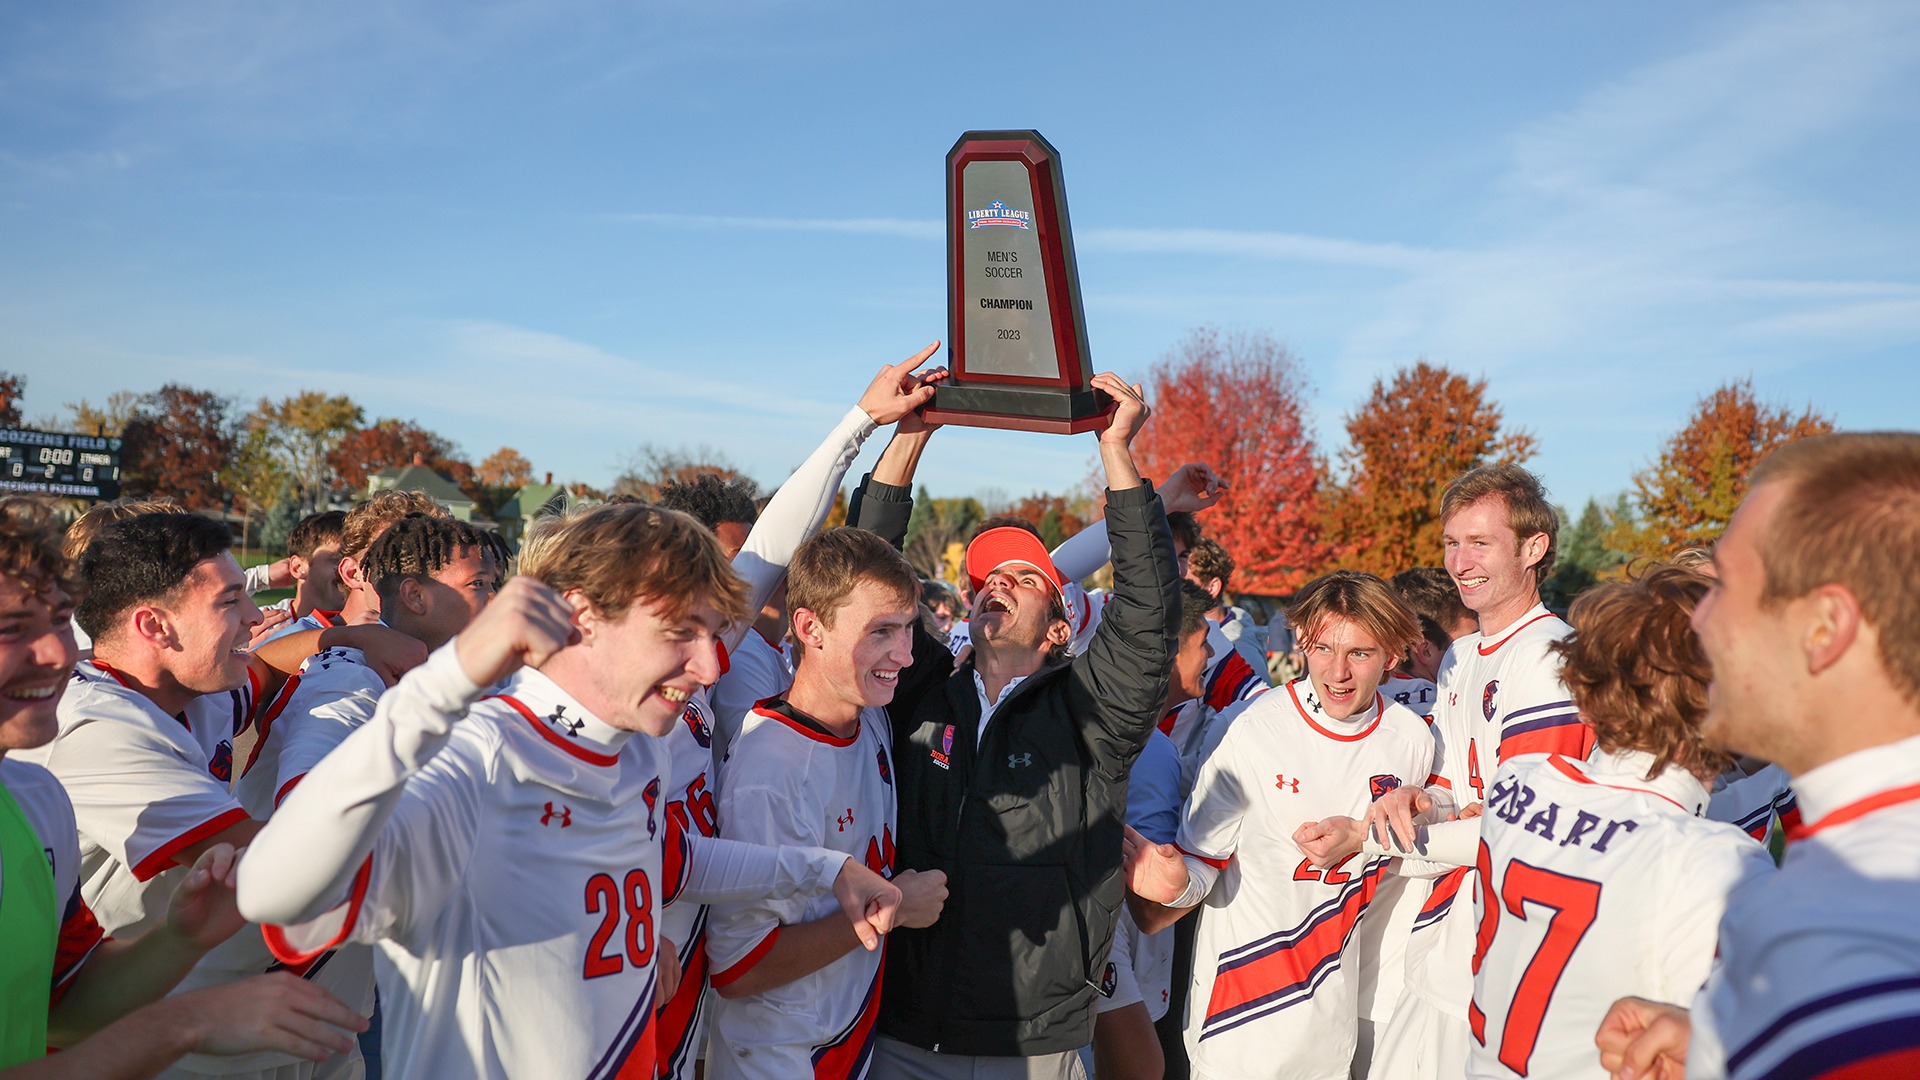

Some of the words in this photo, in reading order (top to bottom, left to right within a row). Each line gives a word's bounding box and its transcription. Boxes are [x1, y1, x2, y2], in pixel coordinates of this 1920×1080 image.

[968, 209, 999, 219] LIBERTY
[1001, 209, 1030, 219] LEAGUE
[987, 251, 1018, 262] MEN'S
[985, 267, 1023, 278] SOCCER
[980, 298, 1033, 310] CHAMPION
[997, 329, 1021, 340] 2023
[0, 429, 65, 447] COZZENS
[67, 436, 107, 450] FIELD
[39, 447, 74, 466] 0:00
[12, 462, 24, 477] 0
[44, 464, 56, 479] 2
[930, 749, 950, 765] HOBA
[1468, 737, 1485, 800] 4
[582, 867, 655, 981] 28
